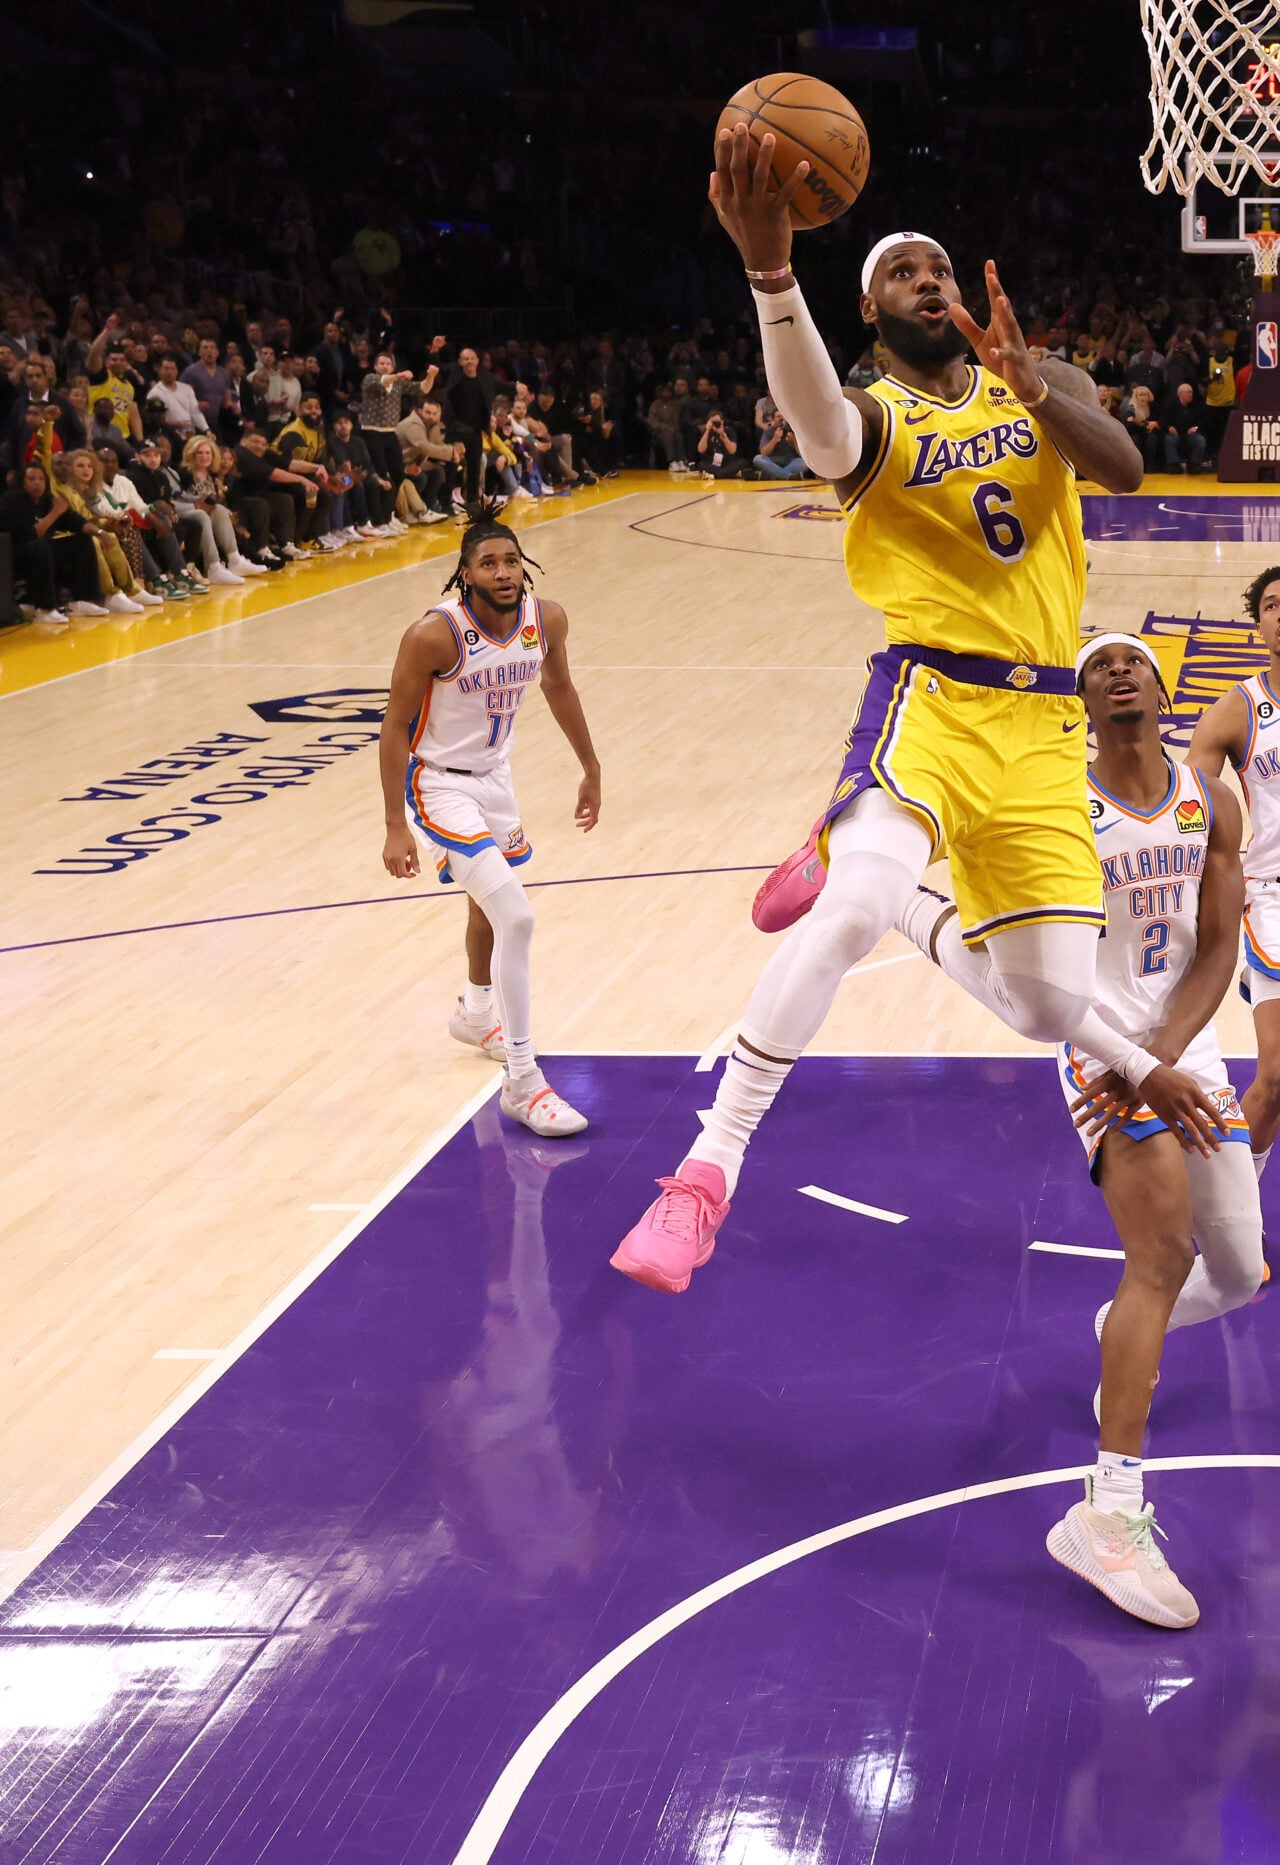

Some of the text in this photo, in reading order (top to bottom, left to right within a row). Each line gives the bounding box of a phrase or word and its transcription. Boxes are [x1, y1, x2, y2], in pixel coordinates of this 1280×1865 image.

[903, 417, 1040, 489] LAKERS
[971, 480, 1028, 565] 6
[456, 660, 542, 695] OKLAHOM
[485, 710, 518, 749] 11
[58, 732, 273, 802] ARENA
[1101, 843, 1208, 893] KLAHOM
[1129, 880, 1185, 919] CITY
[1138, 918, 1171, 978] 2
